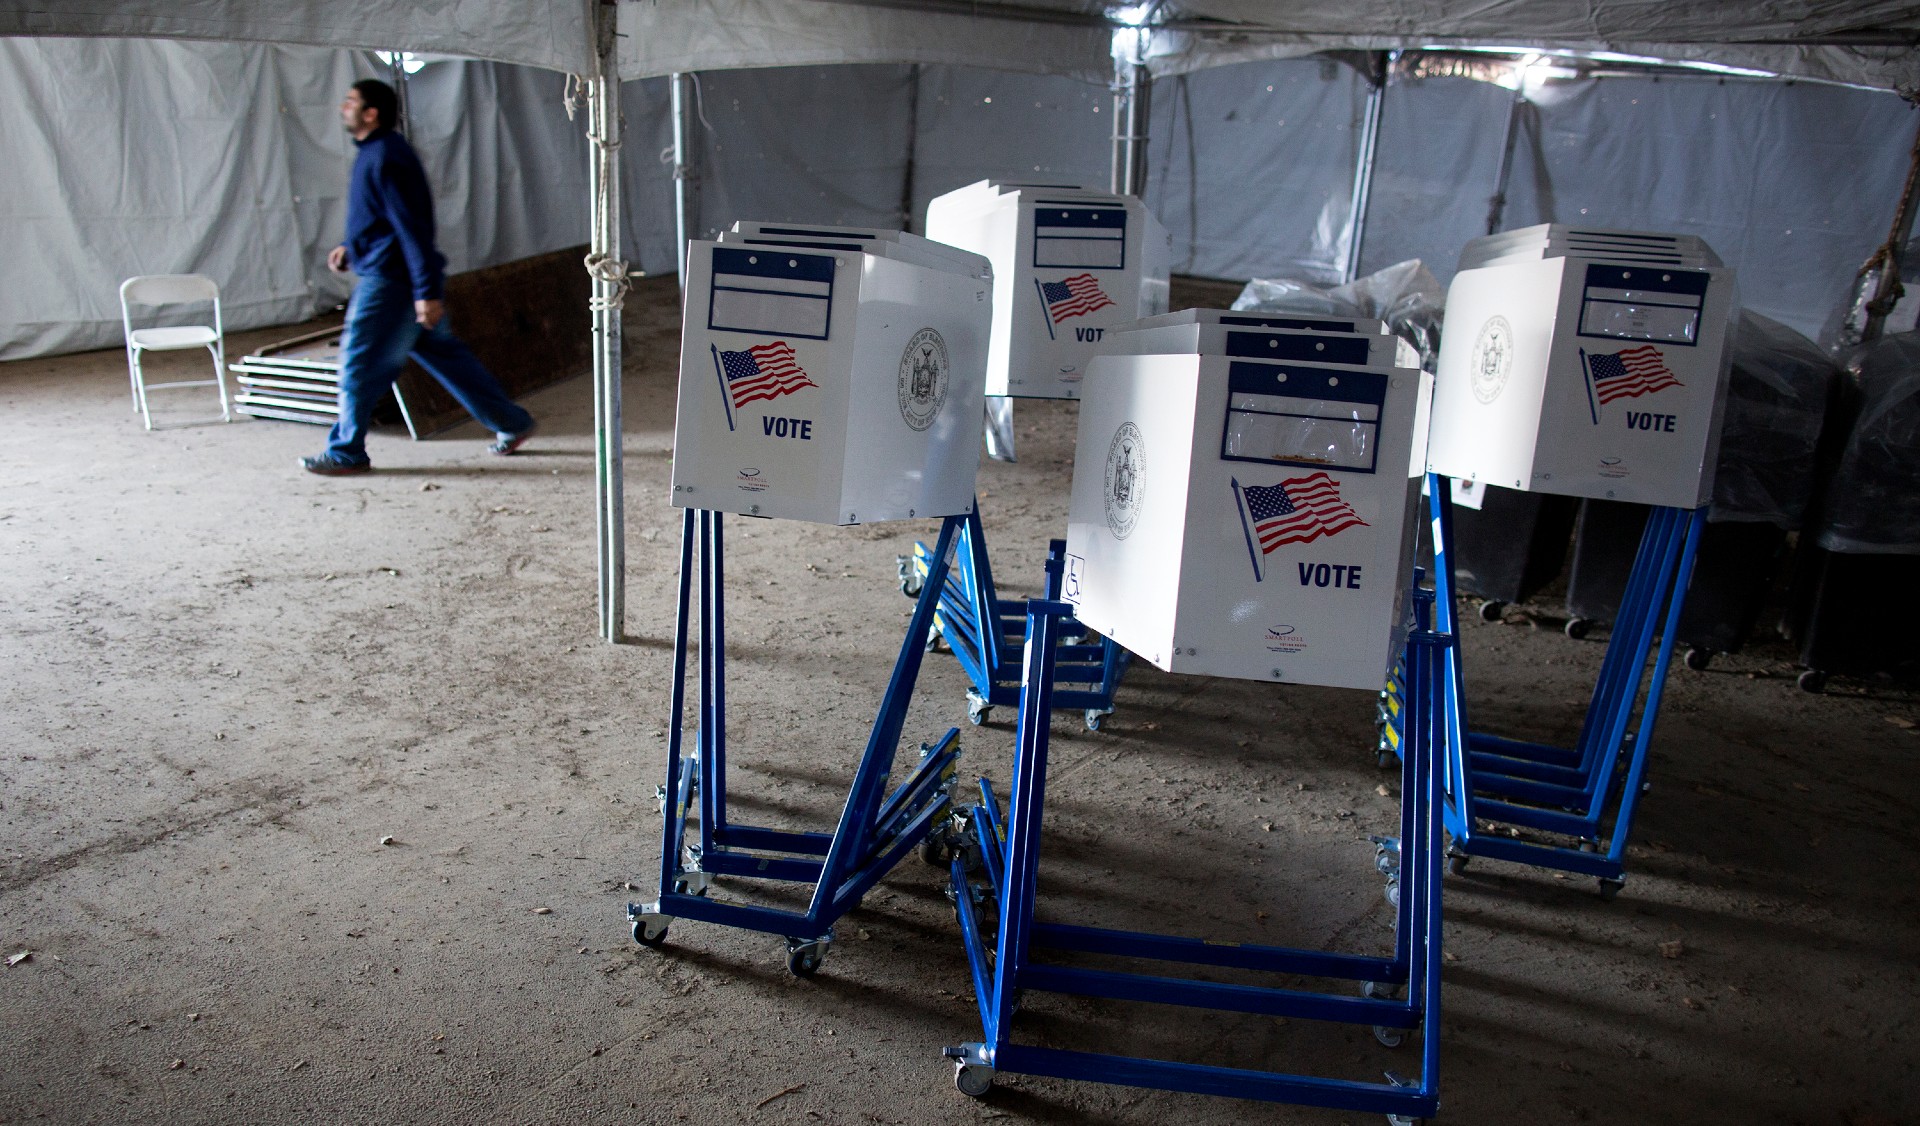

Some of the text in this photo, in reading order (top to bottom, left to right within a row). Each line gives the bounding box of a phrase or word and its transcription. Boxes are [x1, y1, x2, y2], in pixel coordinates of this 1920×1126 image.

[1075, 327, 1104, 342] VOT
[763, 416, 812, 440] VOTE
[1626, 411, 1676, 433] VOTE
[1298, 562, 1362, 590] VOTE
